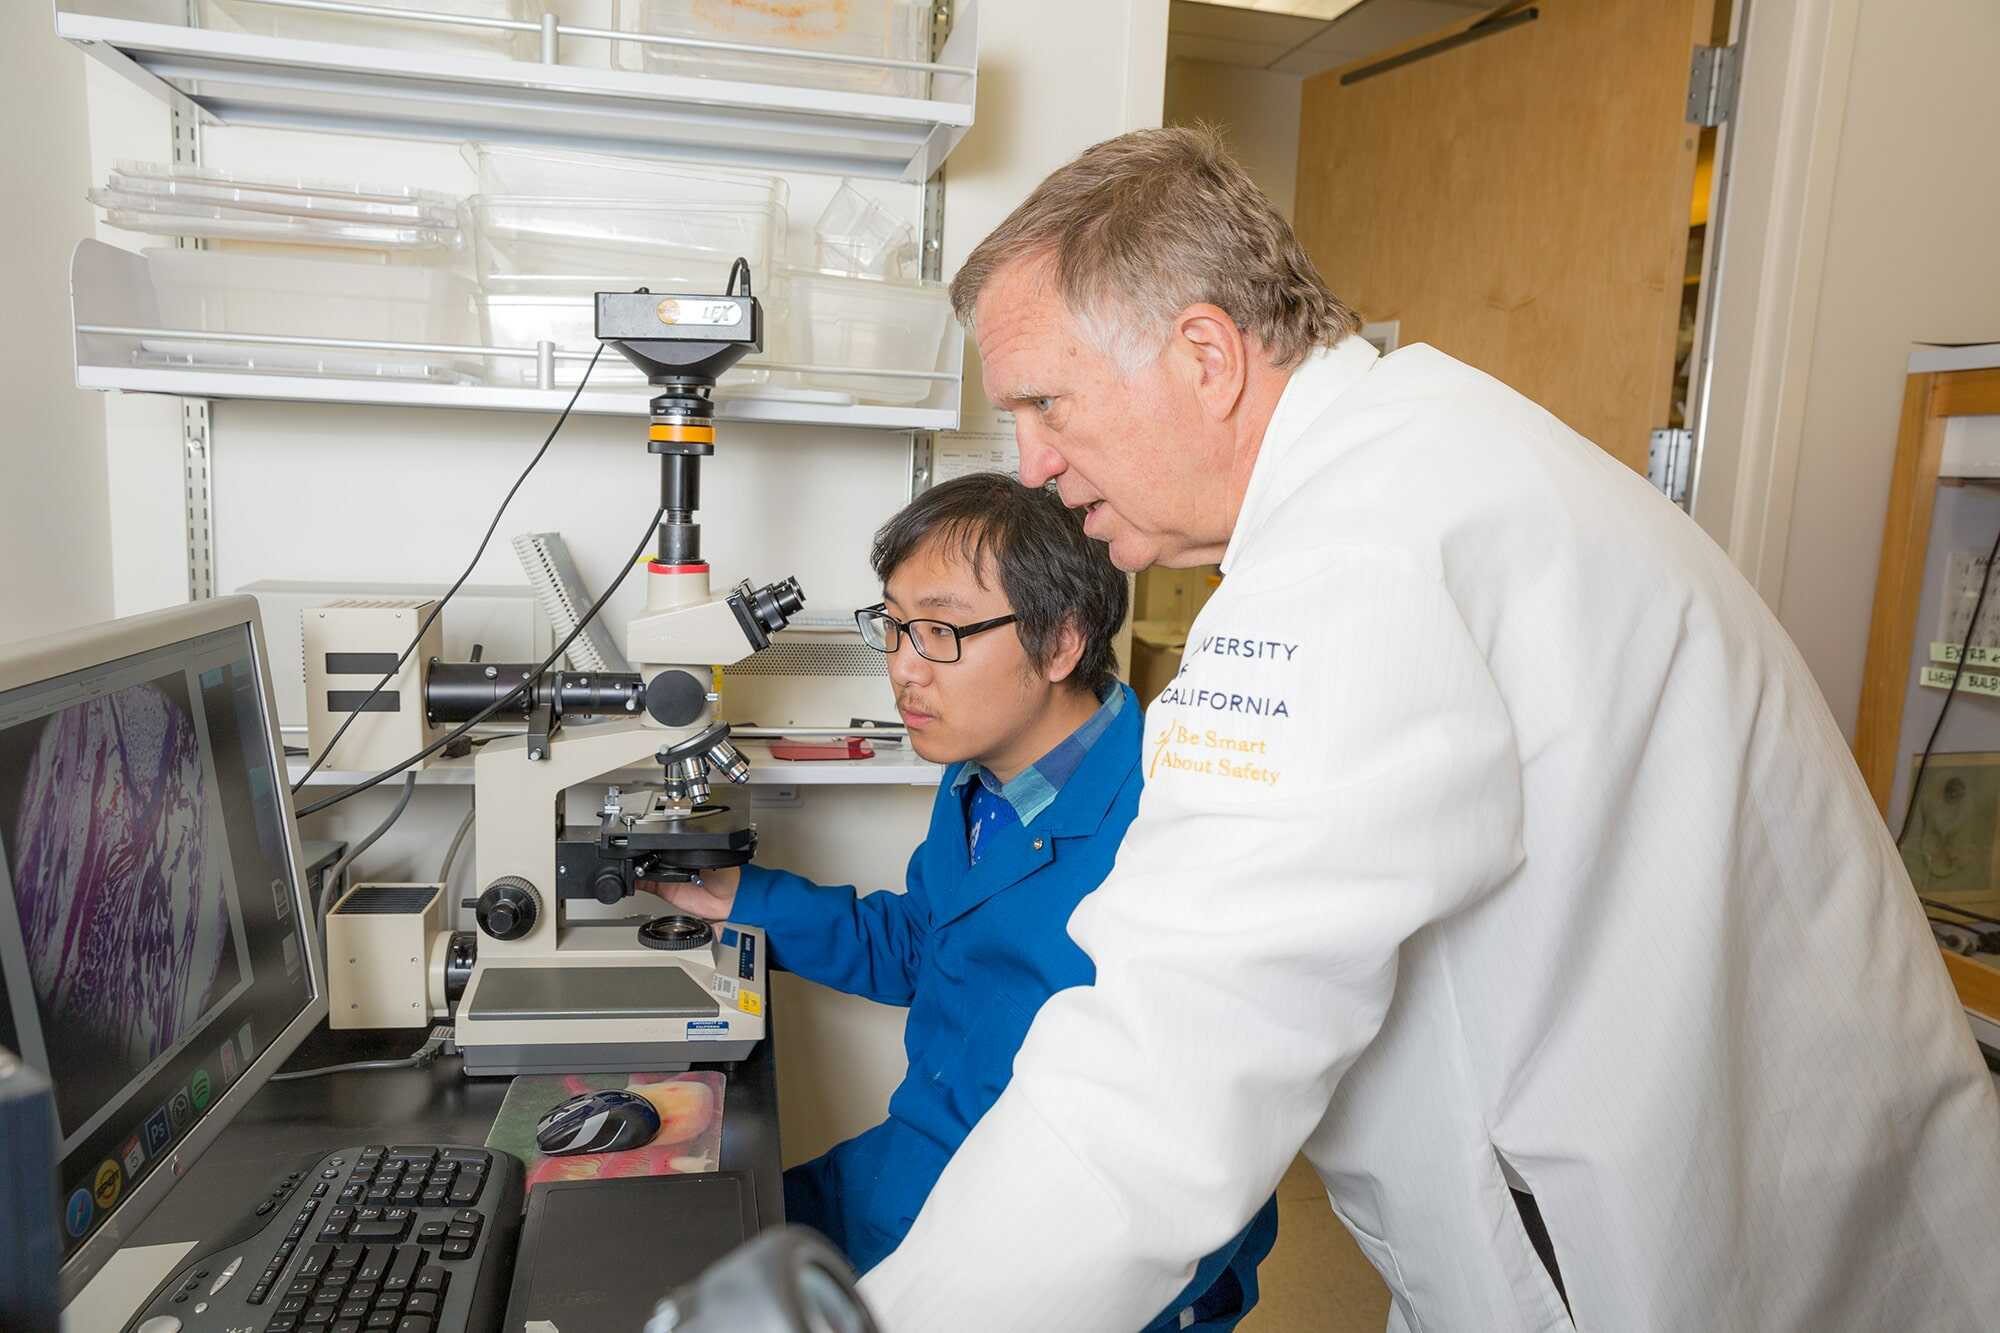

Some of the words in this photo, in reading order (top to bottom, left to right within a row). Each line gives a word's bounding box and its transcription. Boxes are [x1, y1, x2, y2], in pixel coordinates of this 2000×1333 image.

[1201, 635, 1299, 661] VERSITY
[1969, 674, 2000, 691] BULB
[1160, 687, 1289, 717] CALIFORNIA
[1176, 726, 1200, 745] Be
[1205, 730, 1266, 754] Smart
[1162, 751, 1212, 774] About
[1218, 757, 1281, 785] Safety
[151, 1122, 166, 1145] Ps
